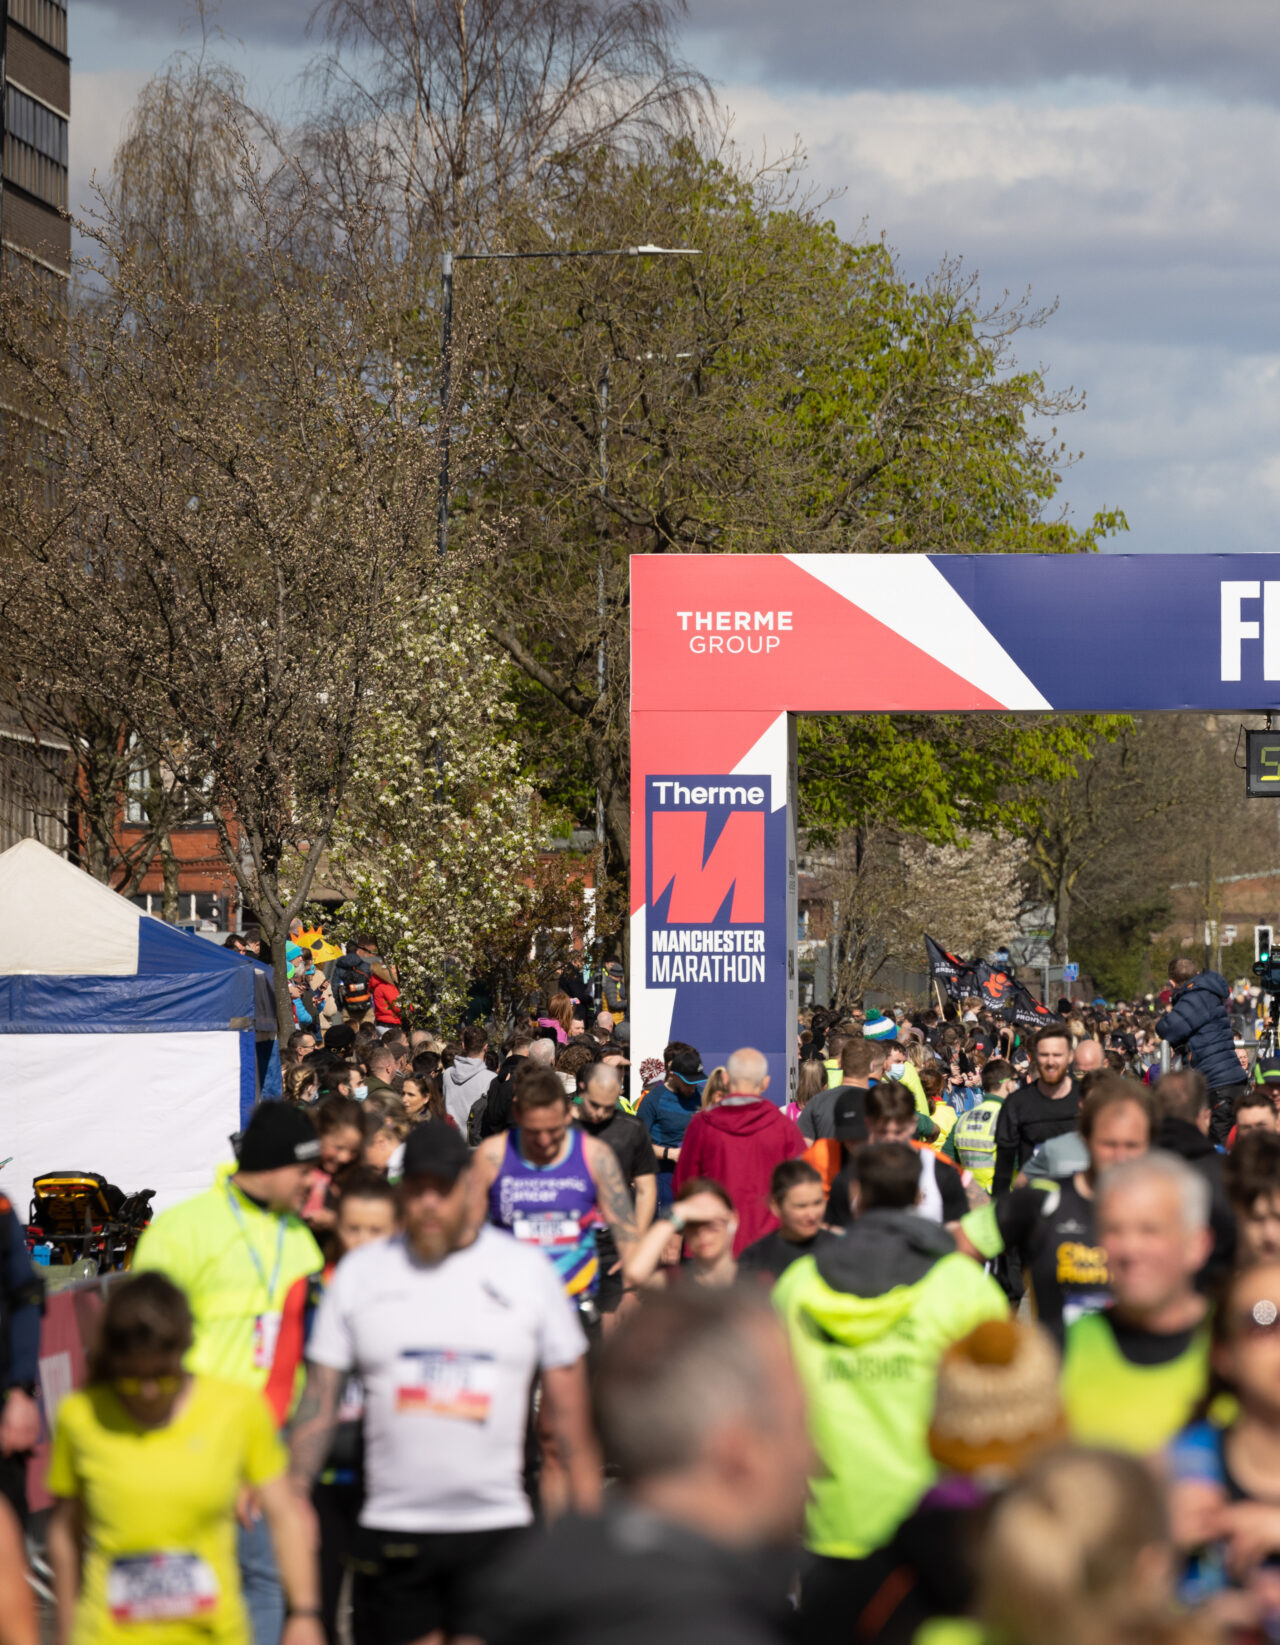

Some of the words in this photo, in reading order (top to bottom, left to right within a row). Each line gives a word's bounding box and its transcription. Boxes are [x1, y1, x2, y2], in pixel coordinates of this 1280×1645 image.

[676, 611, 793, 631] THERME
[689, 635, 781, 654] GROUP
[652, 781, 765, 805] Therme
[652, 930, 766, 953] MANCHESTER
[652, 954, 766, 983] MARATHON
